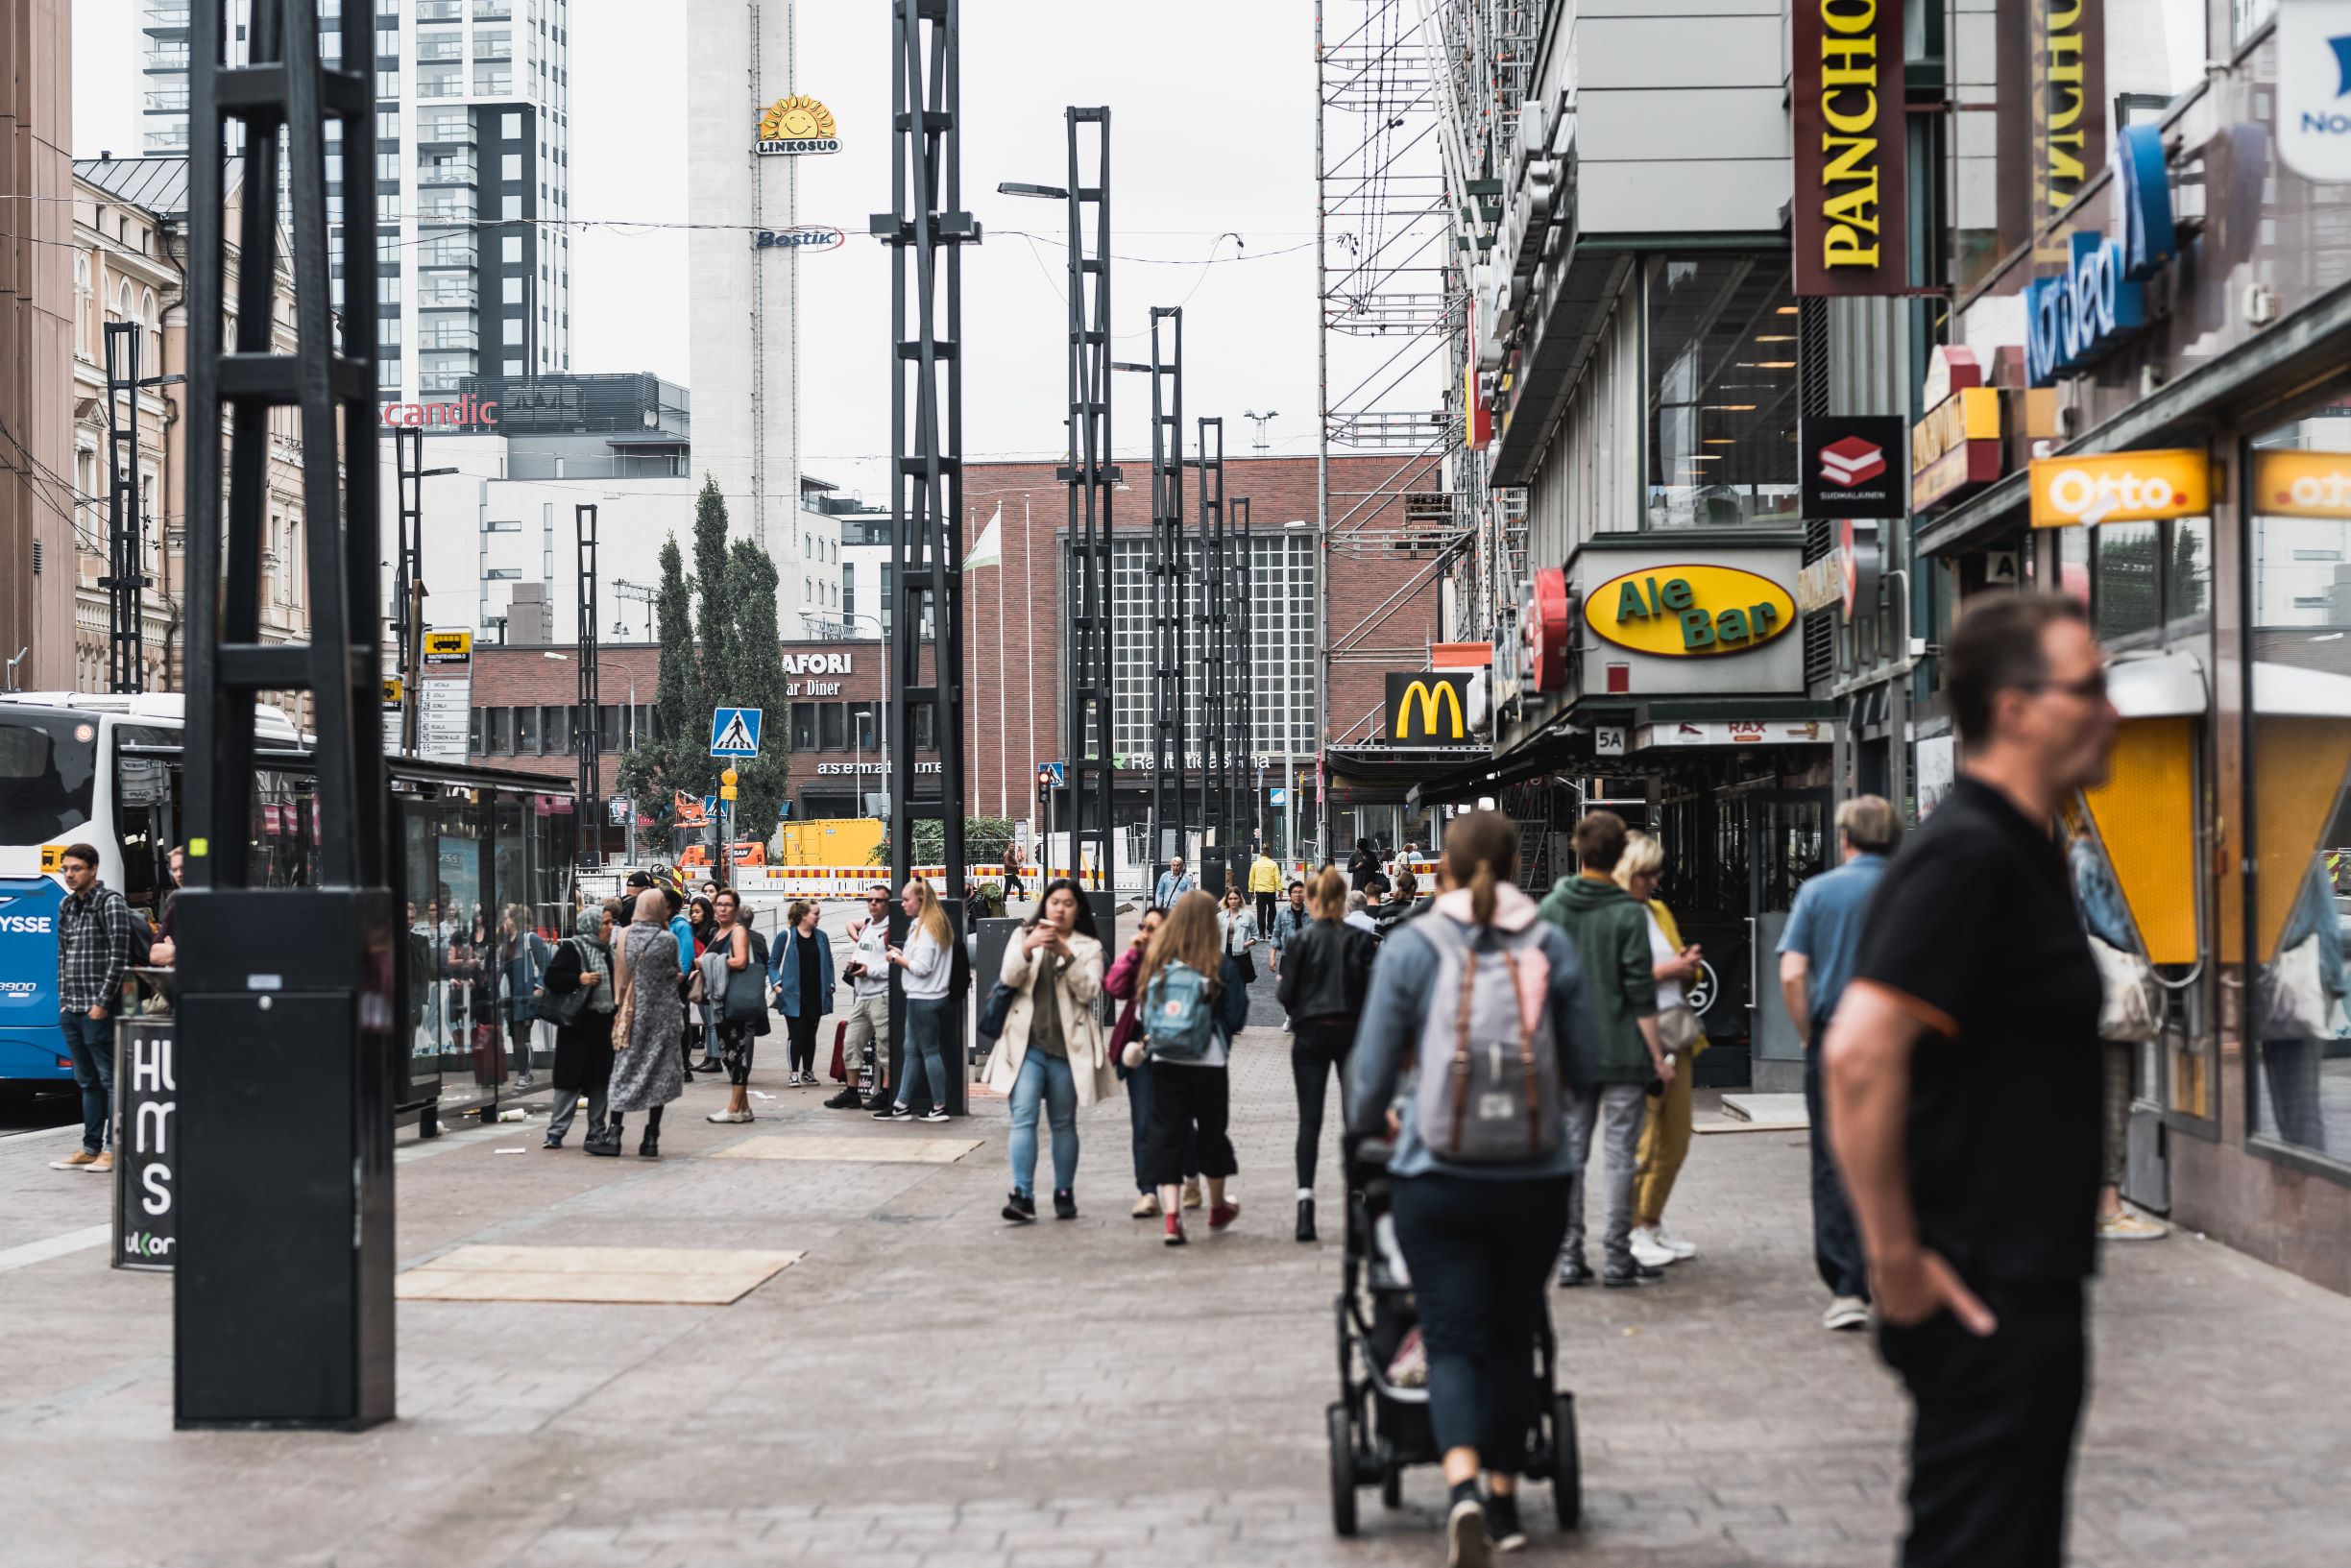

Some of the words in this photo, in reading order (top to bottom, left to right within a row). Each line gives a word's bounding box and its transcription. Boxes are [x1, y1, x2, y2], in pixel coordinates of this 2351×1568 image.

[758, 140, 838, 153] LINKOSUO
[757, 230, 836, 248] Bostik
[377, 393, 497, 426] candic
[1616, 576, 1694, 622] Ale
[1679, 601, 1777, 650] Bar
[806, 679, 841, 696] Diner
[1728, 722, 1767, 734] RAX
[1599, 732, 1623, 748] 5A
